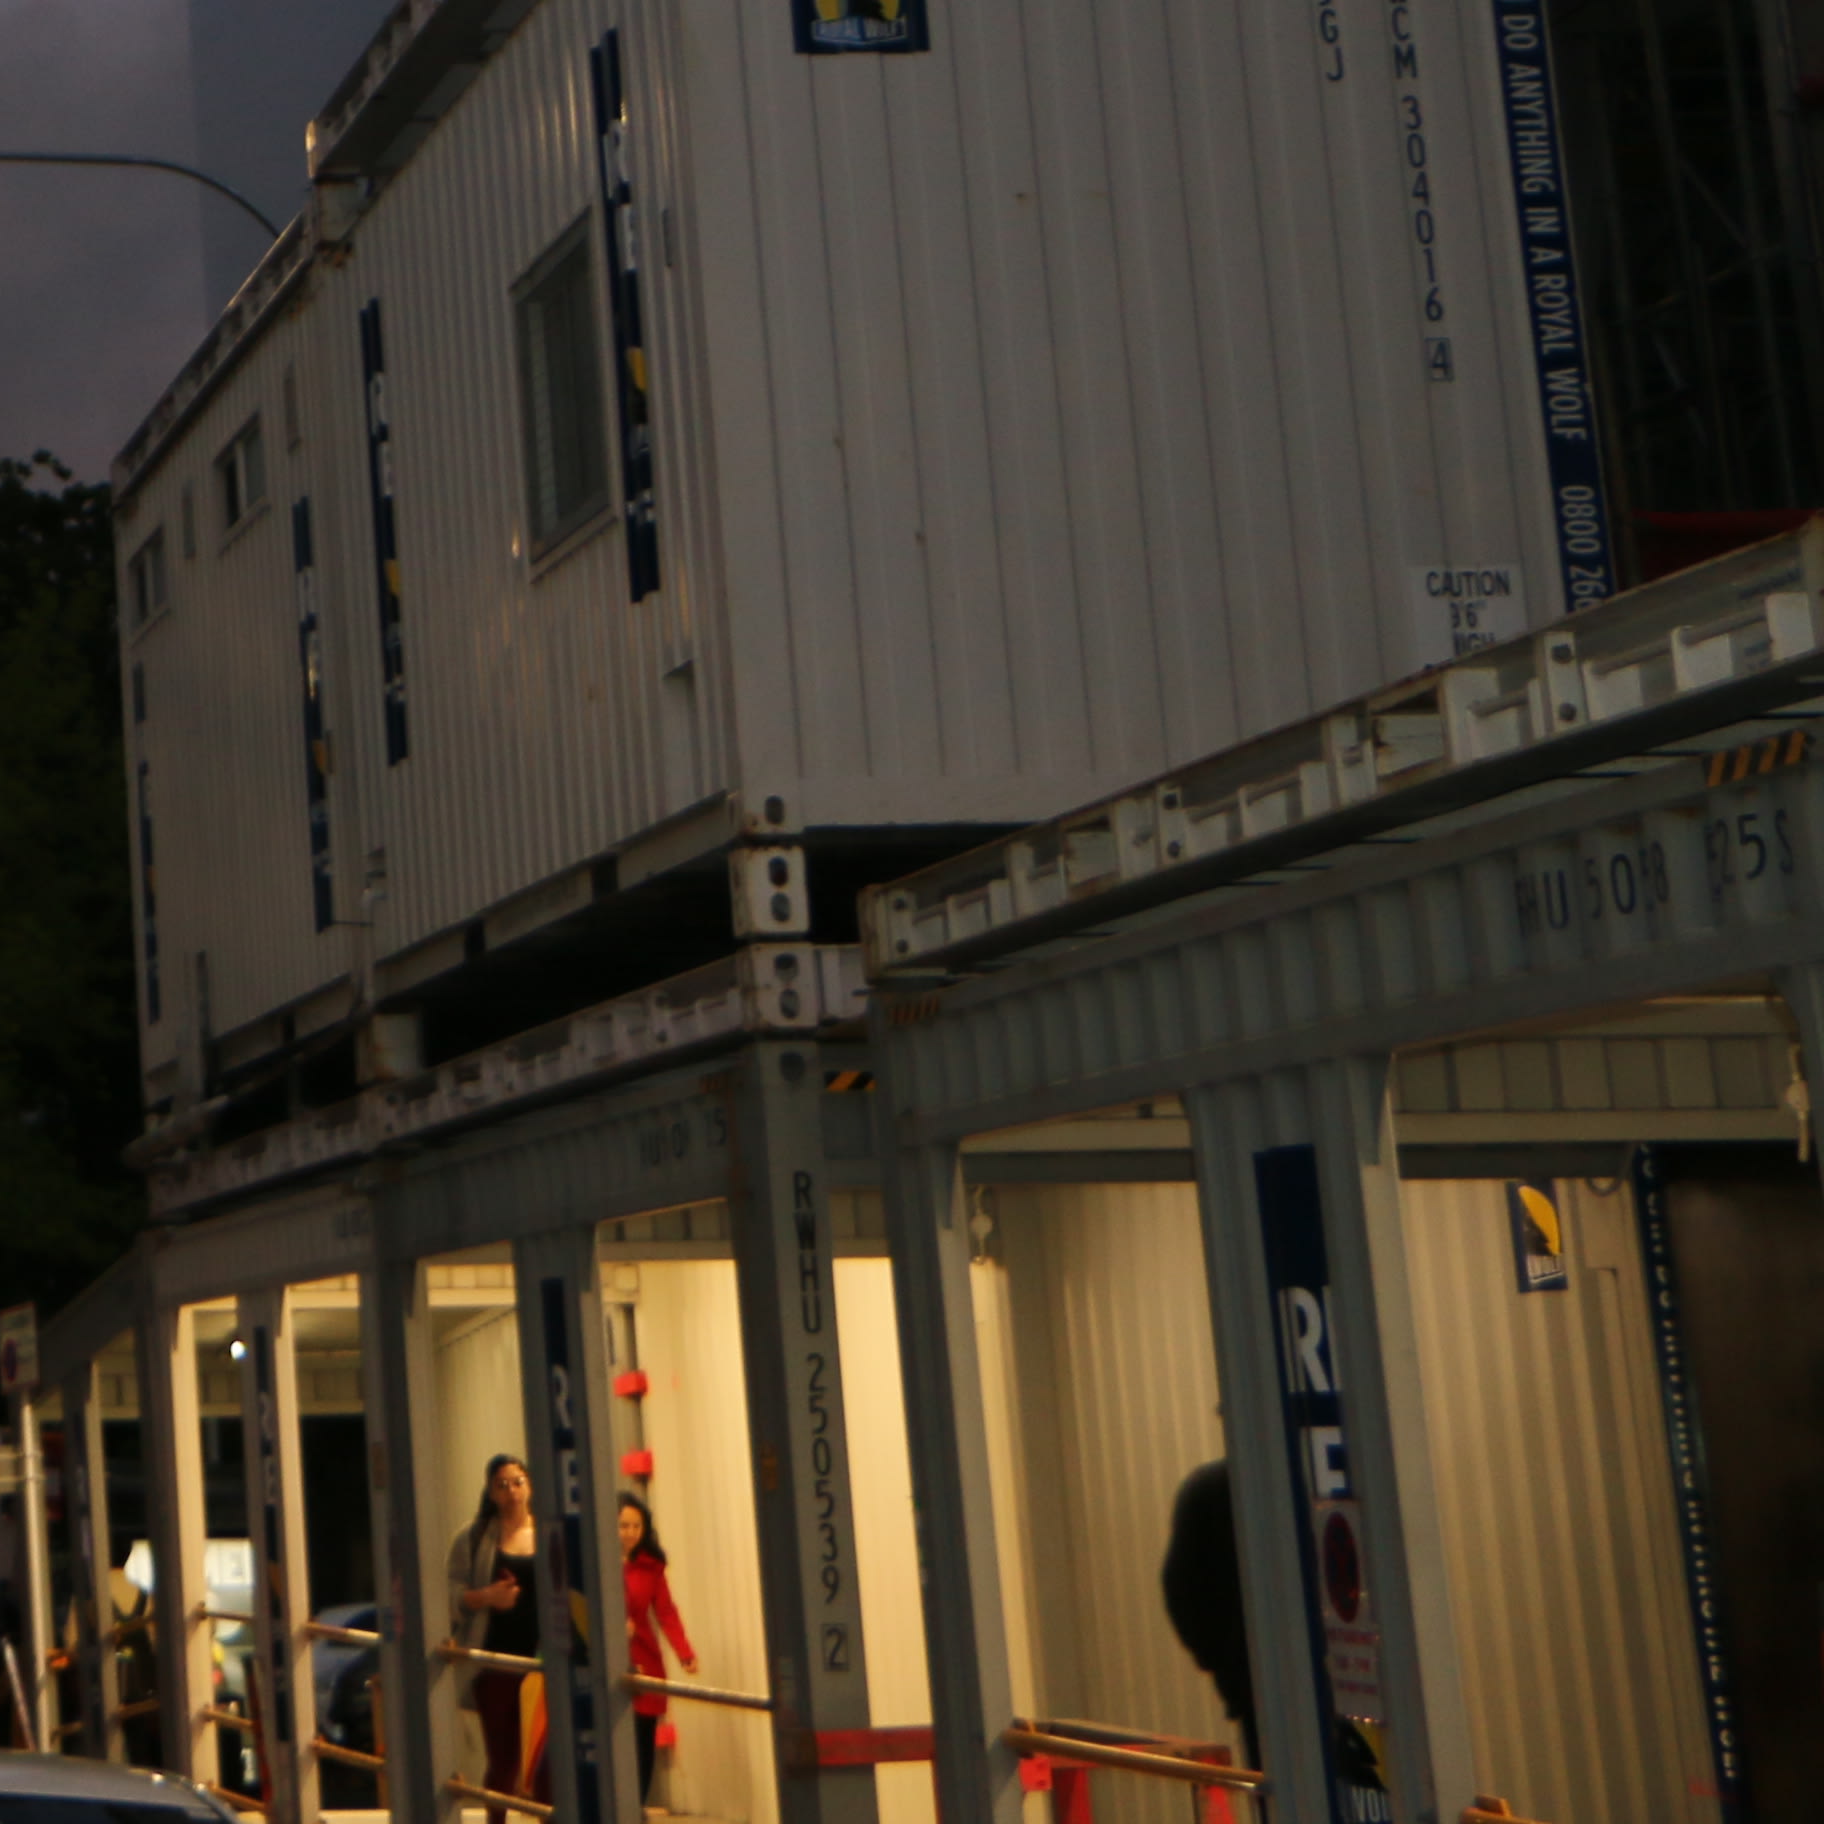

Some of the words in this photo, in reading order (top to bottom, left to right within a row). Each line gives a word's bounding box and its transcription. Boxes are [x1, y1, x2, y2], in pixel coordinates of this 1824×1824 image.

[1503, 14, 1539, 52] DO
[1508, 62, 1557, 195] ANYTHING
[1524, 206, 1561, 234] IN
[1529, 245, 1564, 265] A
[1533, 273, 1577, 355] ROYAL
[1545, 366, 1588, 442] WOLF
[1558, 483, 1602, 557] 0800
[1427, 570, 1510, 596] CAUTION
[793, 1170, 822, 1333] RWHU
[807, 1352, 840, 1605] 250539
